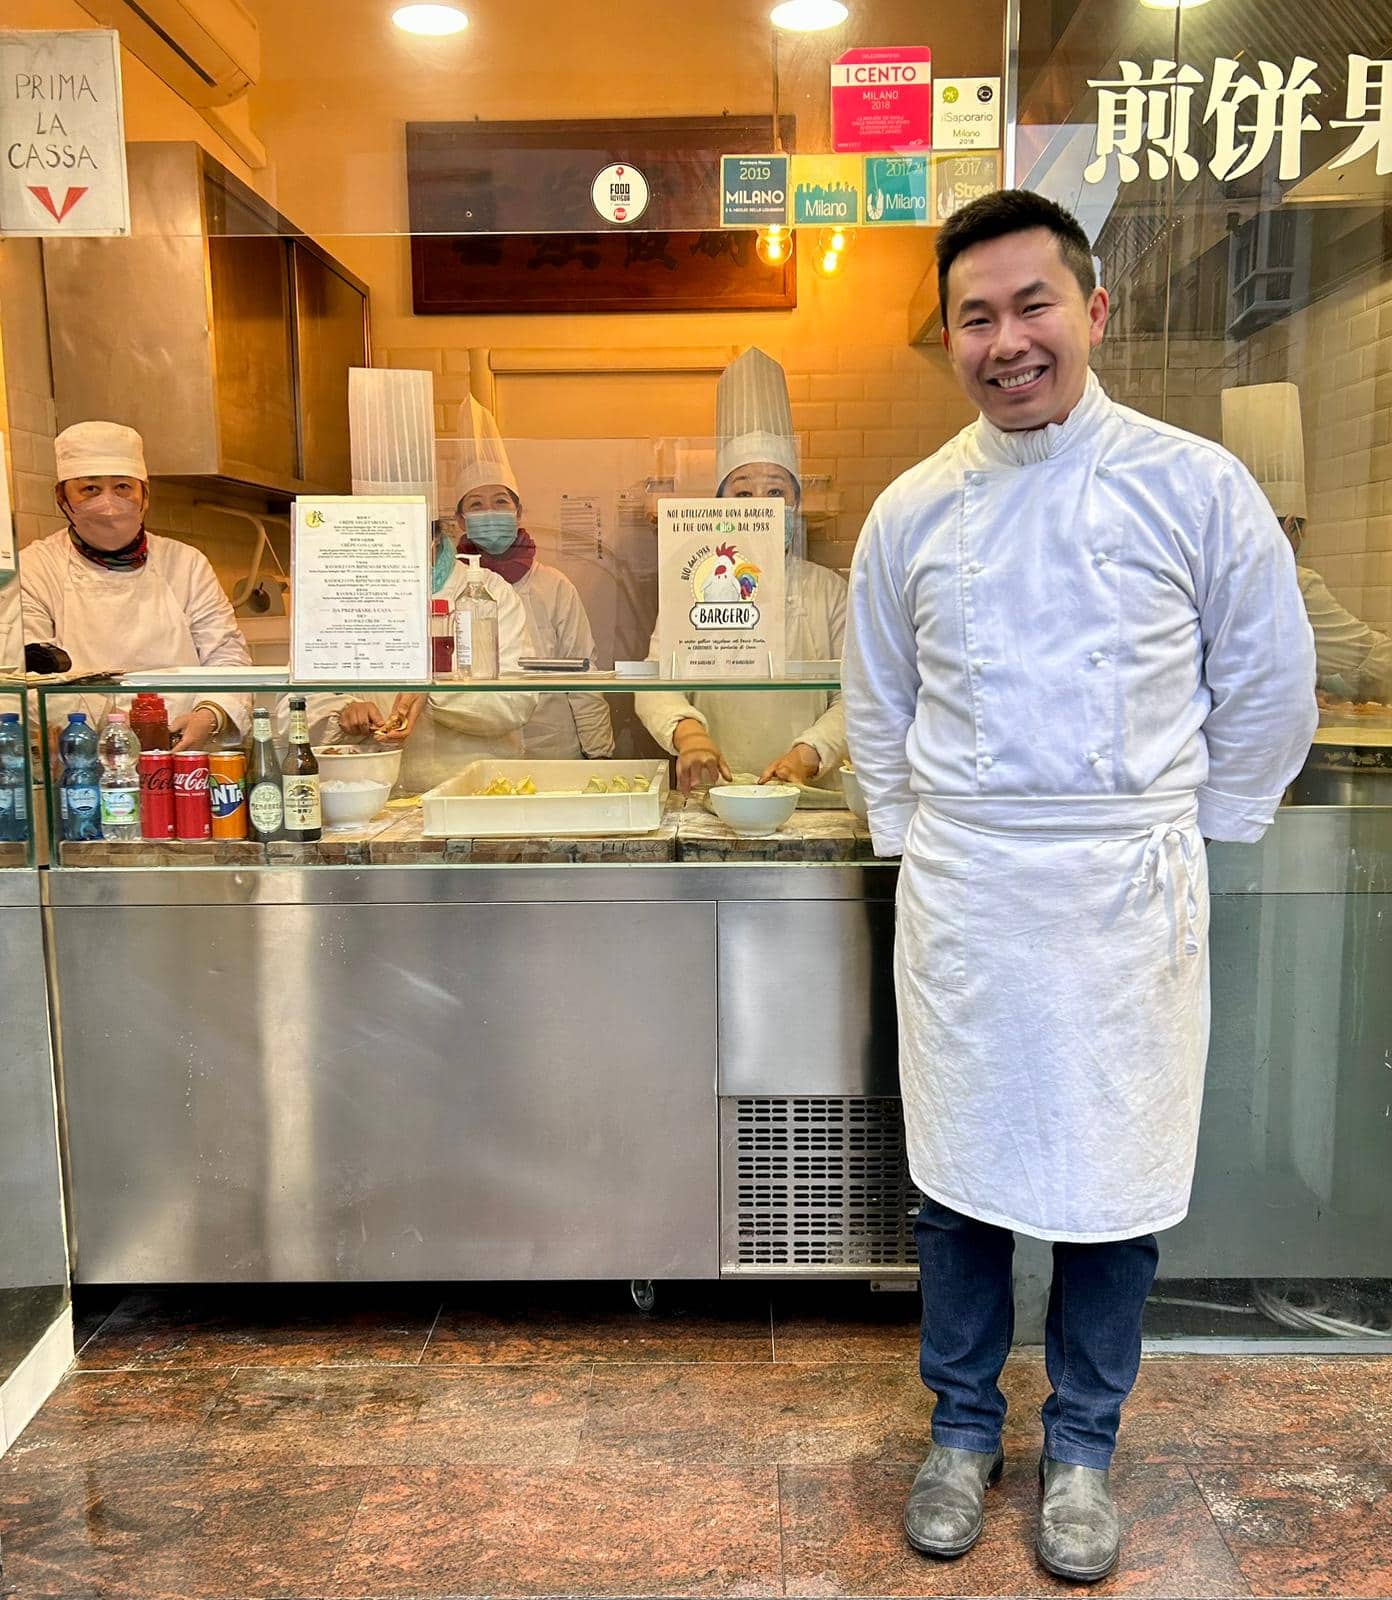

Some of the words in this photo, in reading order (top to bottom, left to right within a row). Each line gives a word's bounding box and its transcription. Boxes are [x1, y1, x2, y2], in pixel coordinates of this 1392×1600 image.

[845, 67, 851, 84] I
[854, 66, 917, 83] CENTO
[15, 73, 99, 102] PRIMA
[862, 90, 899, 101] MILANO
[871, 101, 891, 110] 2018
[36, 111, 68, 137] LA
[952, 128, 981, 138] Milano
[7, 142, 98, 170] CASSA
[739, 167, 771, 180] 2019
[954, 161, 981, 176] 2017
[610, 183, 630, 195] FOOD
[726, 190, 785, 204] MILANO
[885, 192, 926, 210] Milano
[805, 199, 847, 217] Milano
[667, 508, 679, 518] NOI
[680, 507, 723, 518] UTILIZZIAMO
[725, 508, 742, 518] UOVA
[672, 523, 680, 532] LE
[683, 523, 694, 532] TUE
[696, 522, 713, 532] UOVA
[737, 522, 749, 532] DAL
[752, 522, 770, 532] 1988
[680, 567, 691, 581] BIO
[699, 608, 750, 624] BARGERO
